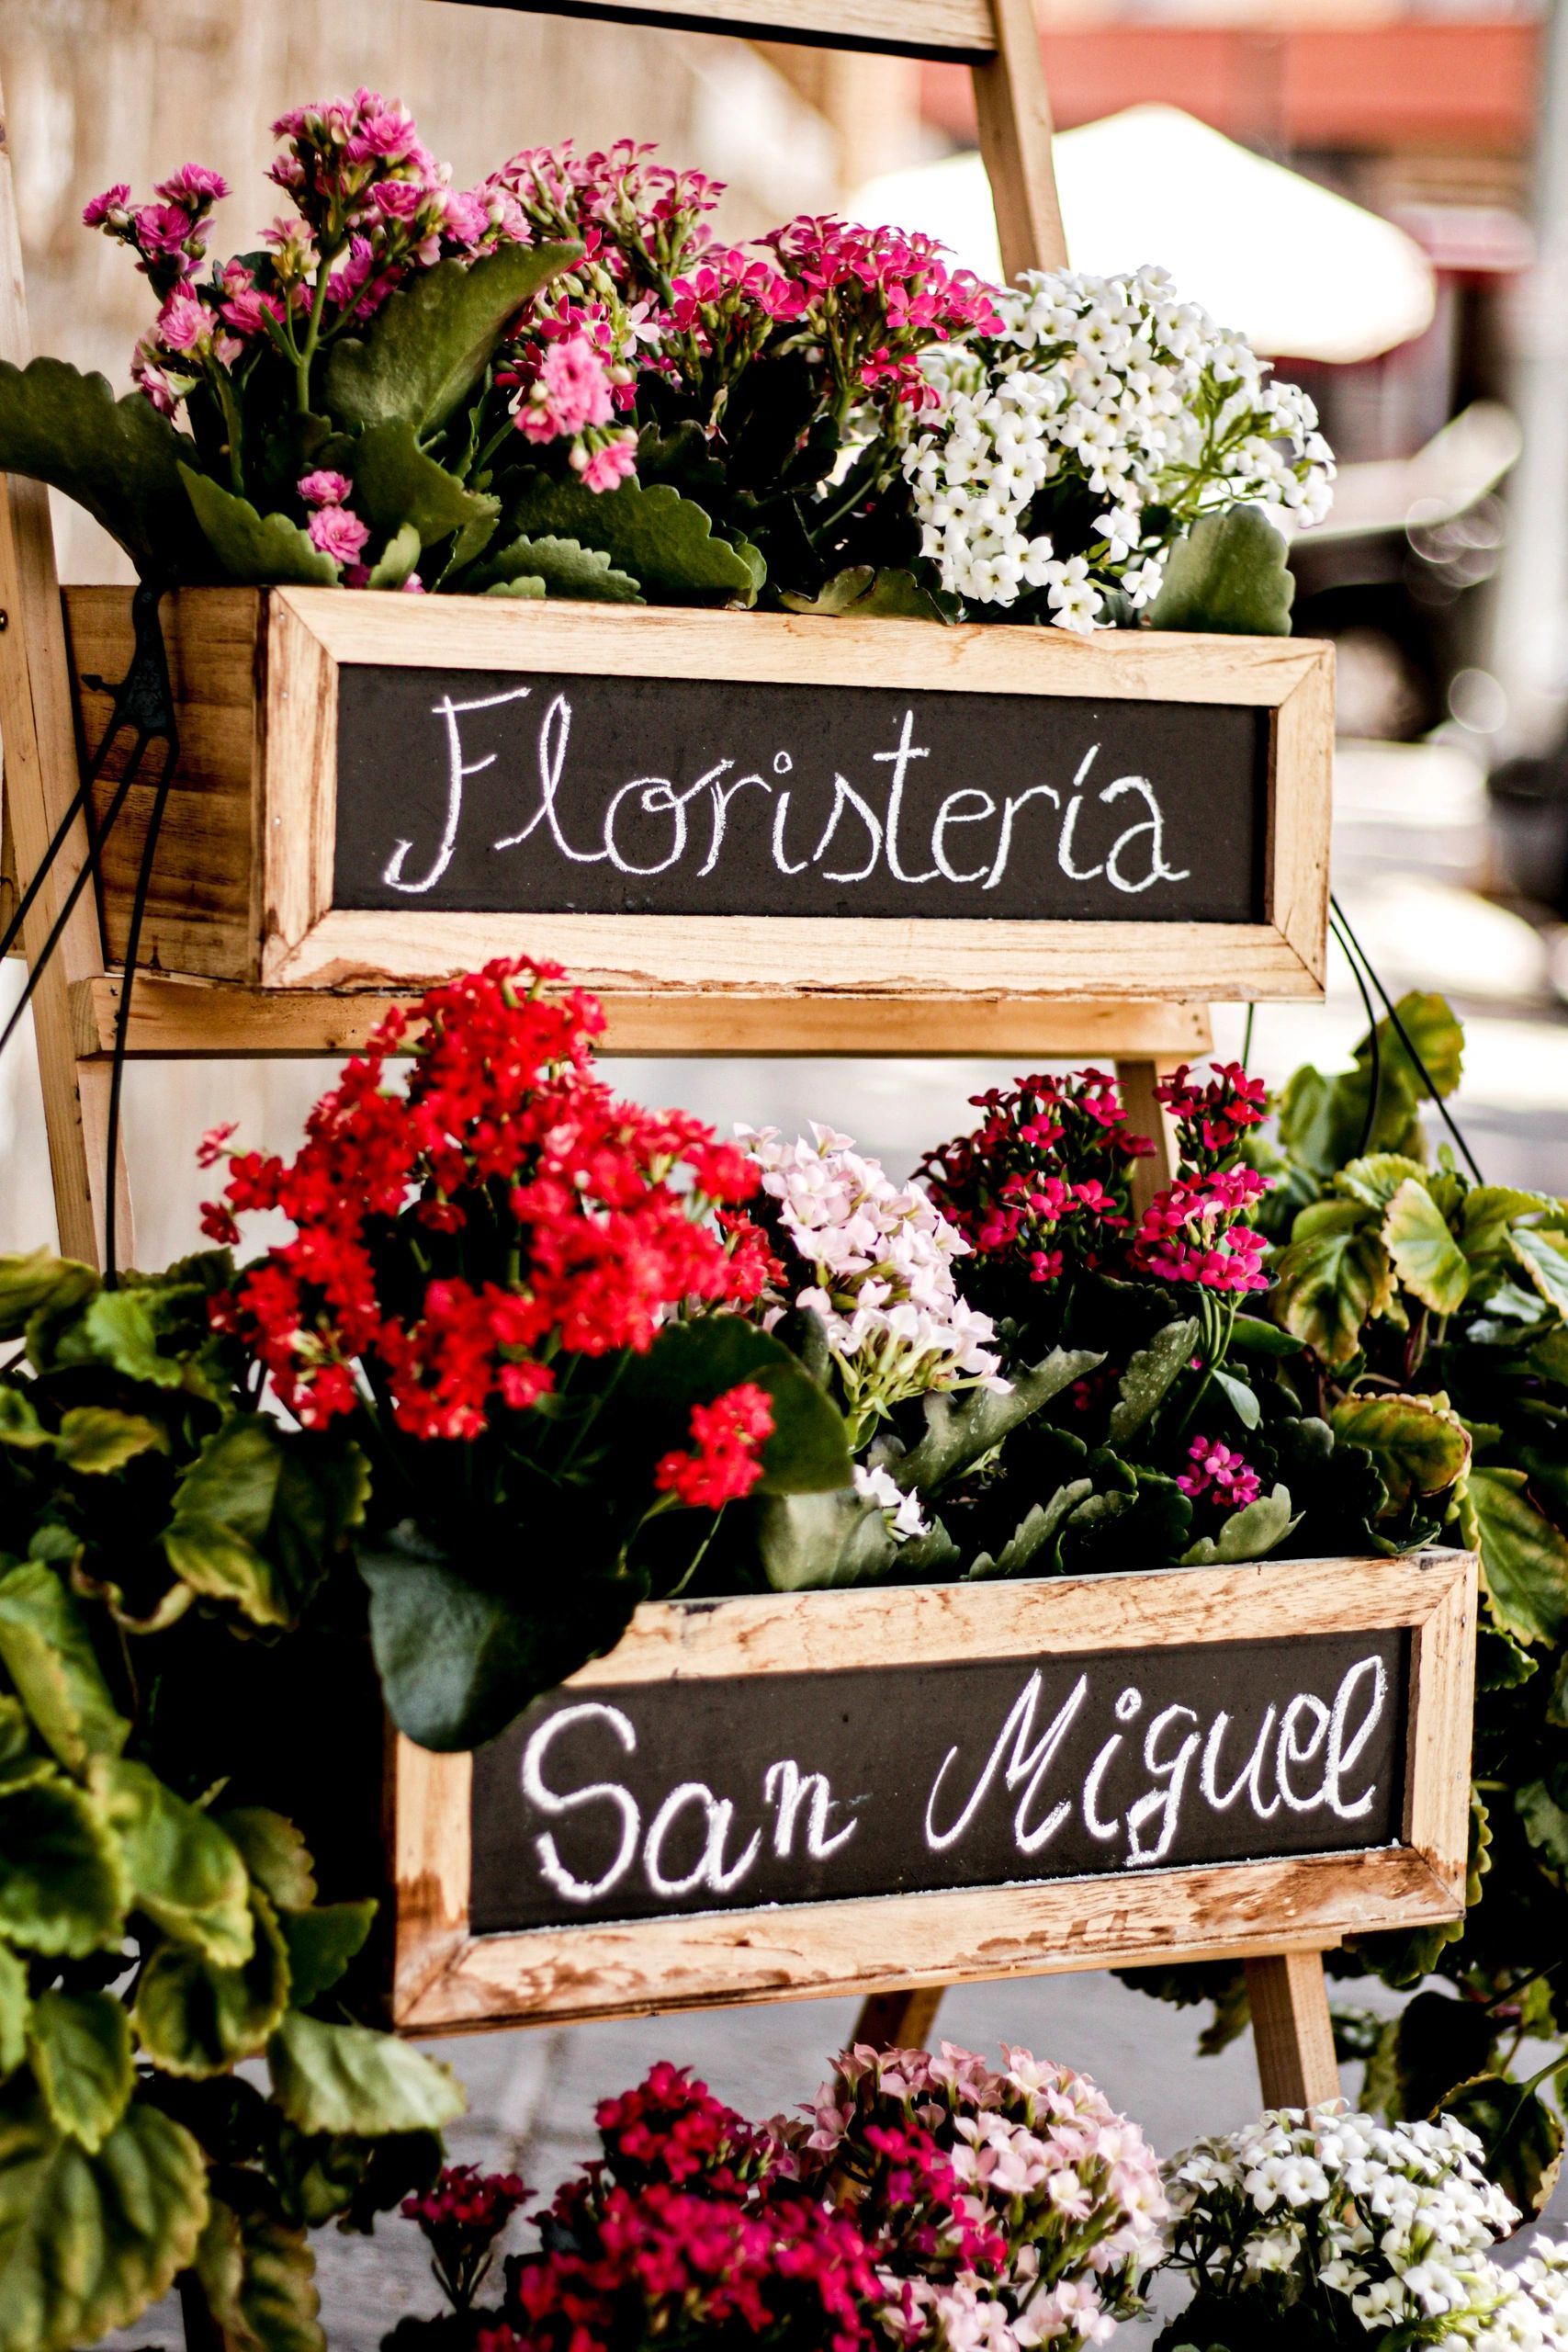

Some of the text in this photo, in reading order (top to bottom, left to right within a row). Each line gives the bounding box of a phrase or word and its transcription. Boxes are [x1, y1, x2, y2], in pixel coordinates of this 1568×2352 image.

[383, 686, 1191, 893] Floristería
[522, 1655, 1389, 1902] San Miguel
